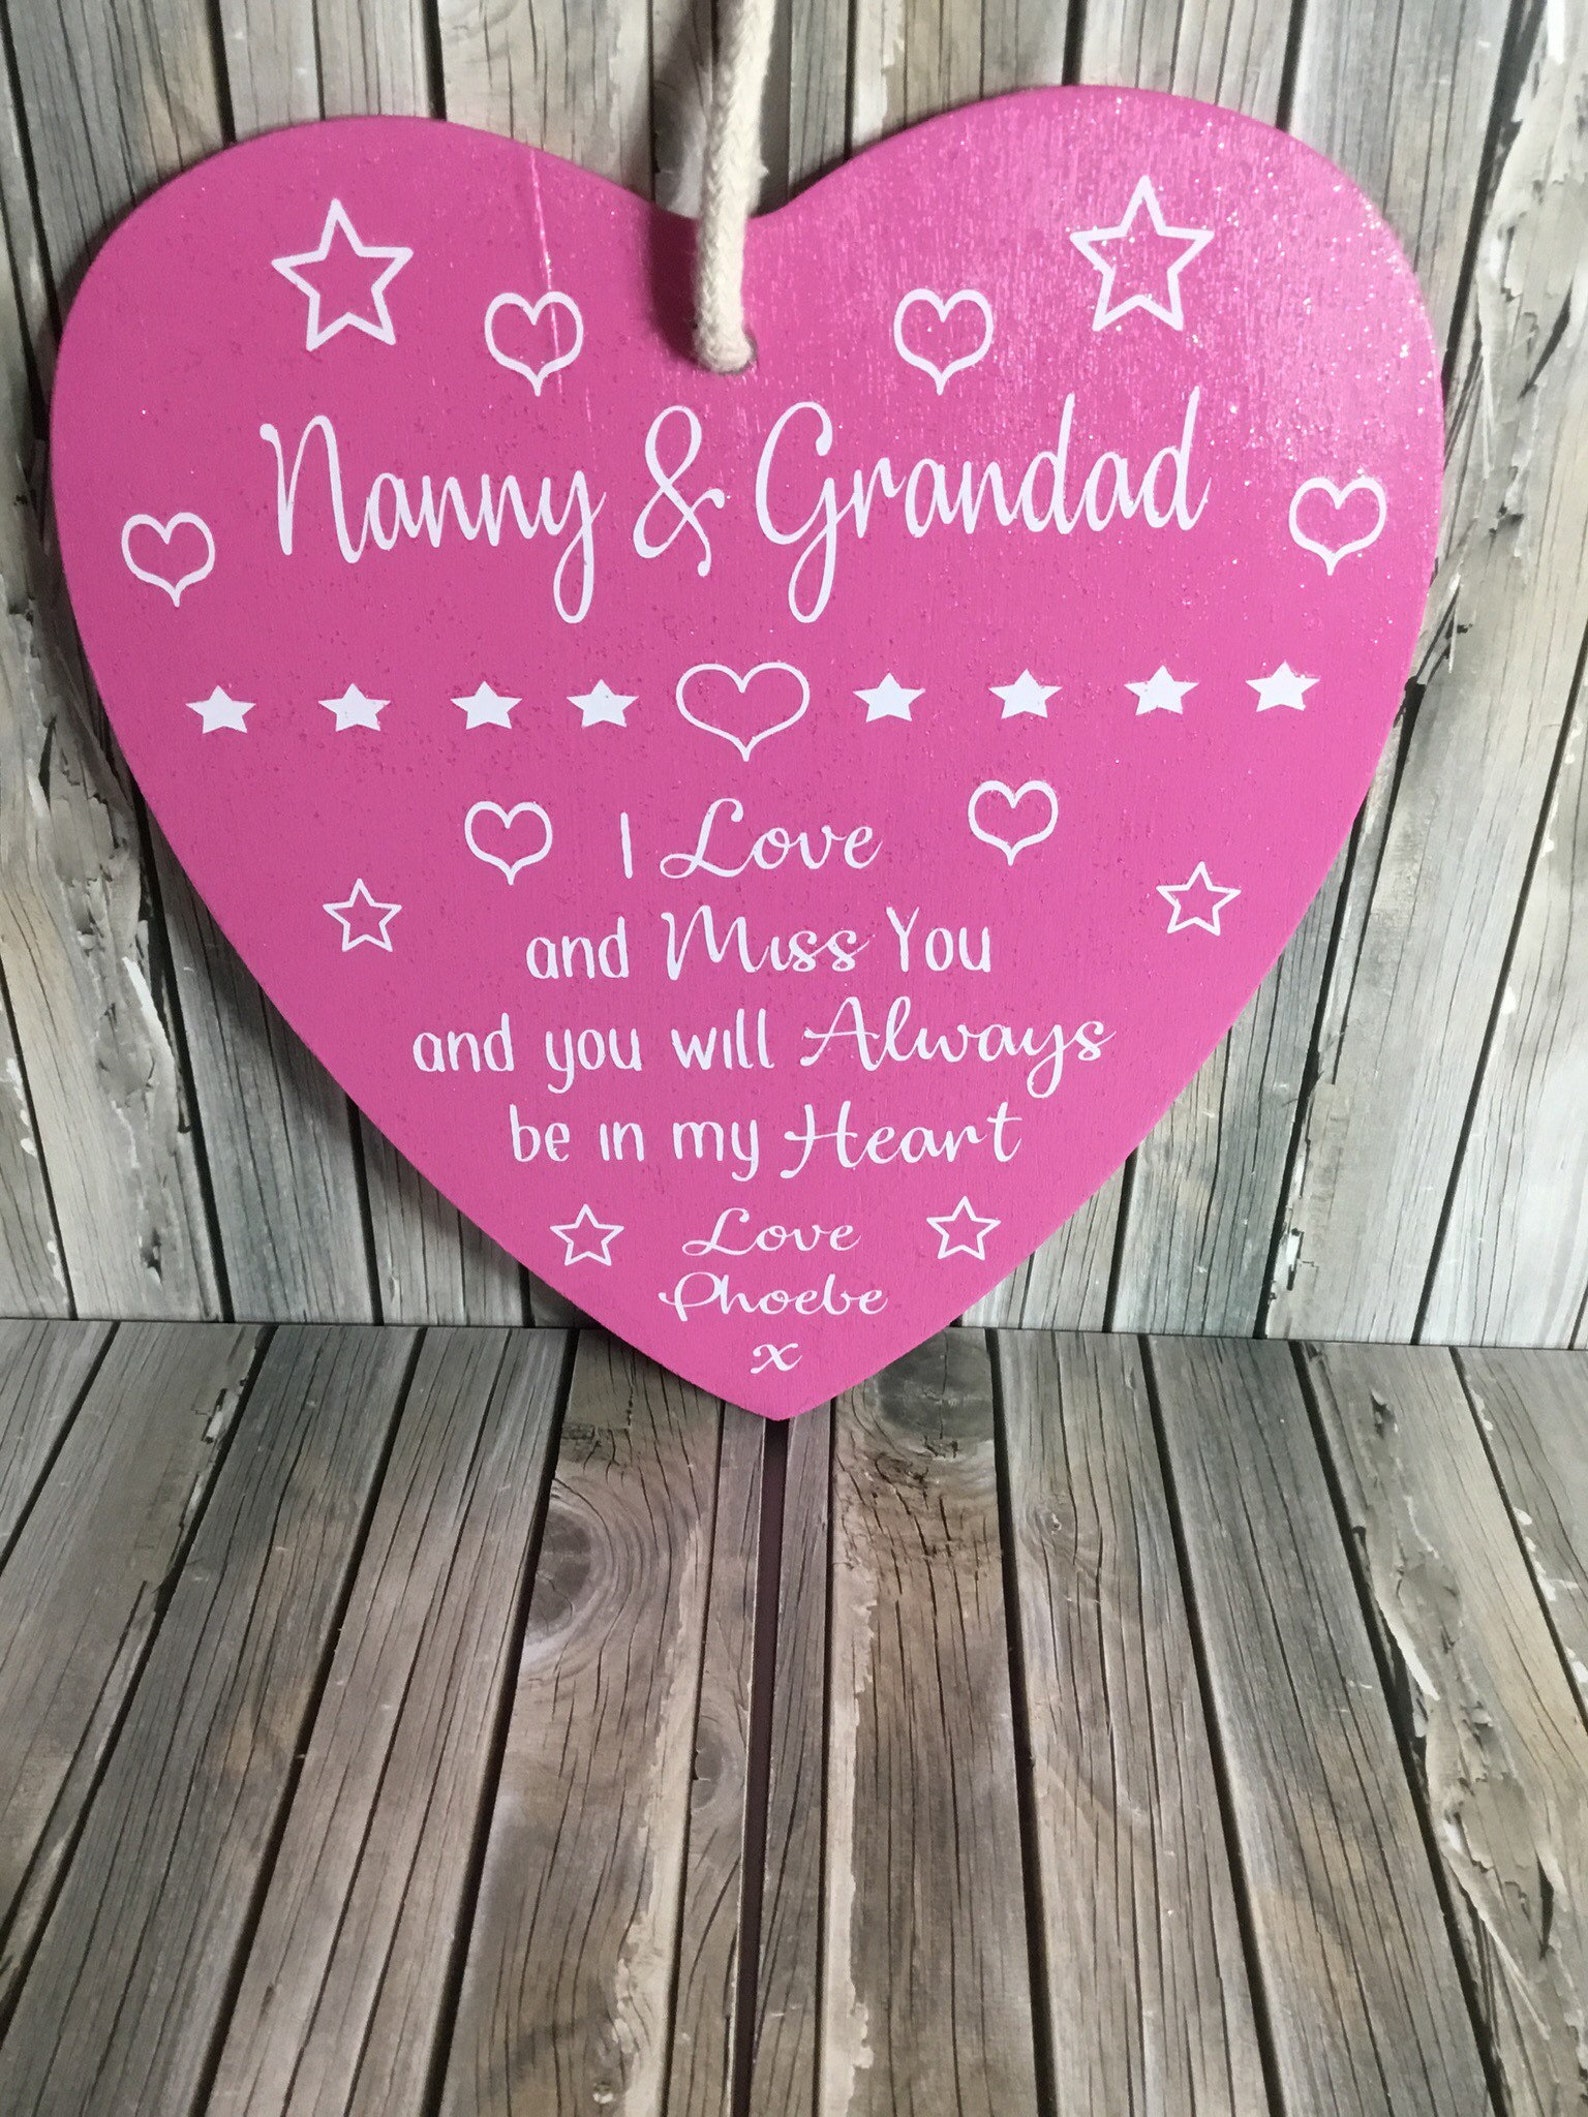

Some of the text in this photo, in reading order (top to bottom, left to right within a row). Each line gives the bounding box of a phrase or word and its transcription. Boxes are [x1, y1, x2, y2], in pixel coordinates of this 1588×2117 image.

[260, 386, 1211, 624] Nanny & Grandad
[621, 797, 882, 880] I Love
[525, 904, 992, 980] and Miss You
[412, 996, 1116, 1099] and you will Always
[509, 1100, 1023, 1182] be in my Heart
[682, 1207, 860, 1256] Love
[658, 1271, 888, 1322] Phoebe
[750, 1342, 803, 1375] x
